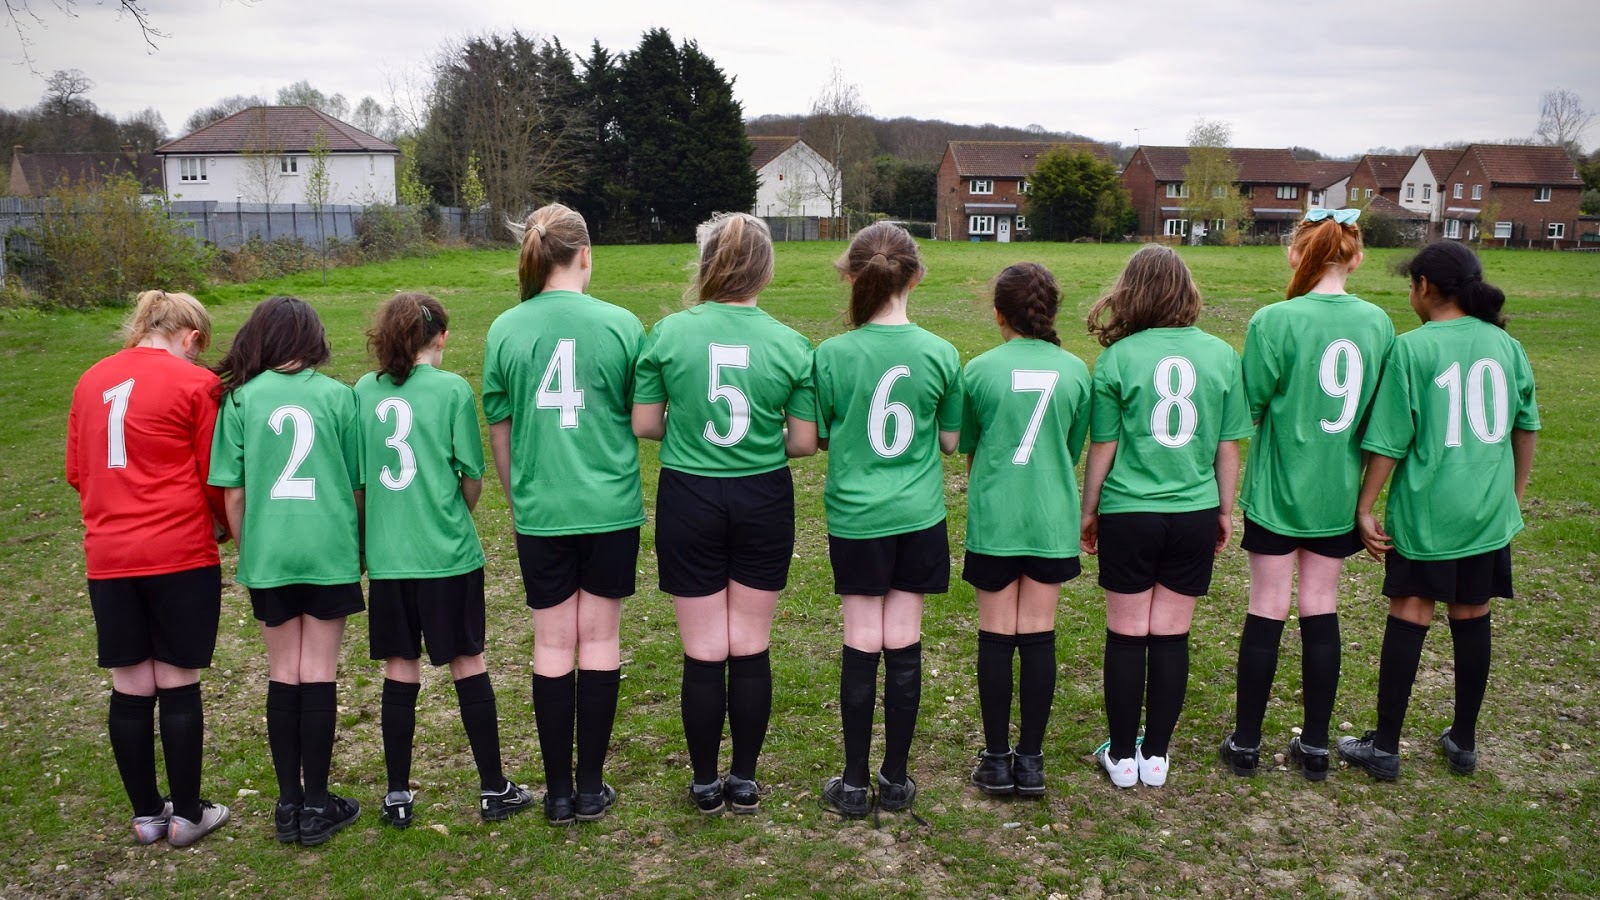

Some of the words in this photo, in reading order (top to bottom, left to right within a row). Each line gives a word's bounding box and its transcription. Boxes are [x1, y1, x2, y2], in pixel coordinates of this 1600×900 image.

[103, 378, 135, 468] 1
[535, 338, 585, 429] 4
[703, 341, 752, 447] 5
[868, 365, 915, 458] 6
[1010, 367, 1061, 465] 7
[1150, 353, 1198, 448] 8
[1319, 338, 1363, 433] 9
[1434, 357, 1509, 447] 10
[267, 403, 316, 501] 2
[375, 396, 417, 491] 3
